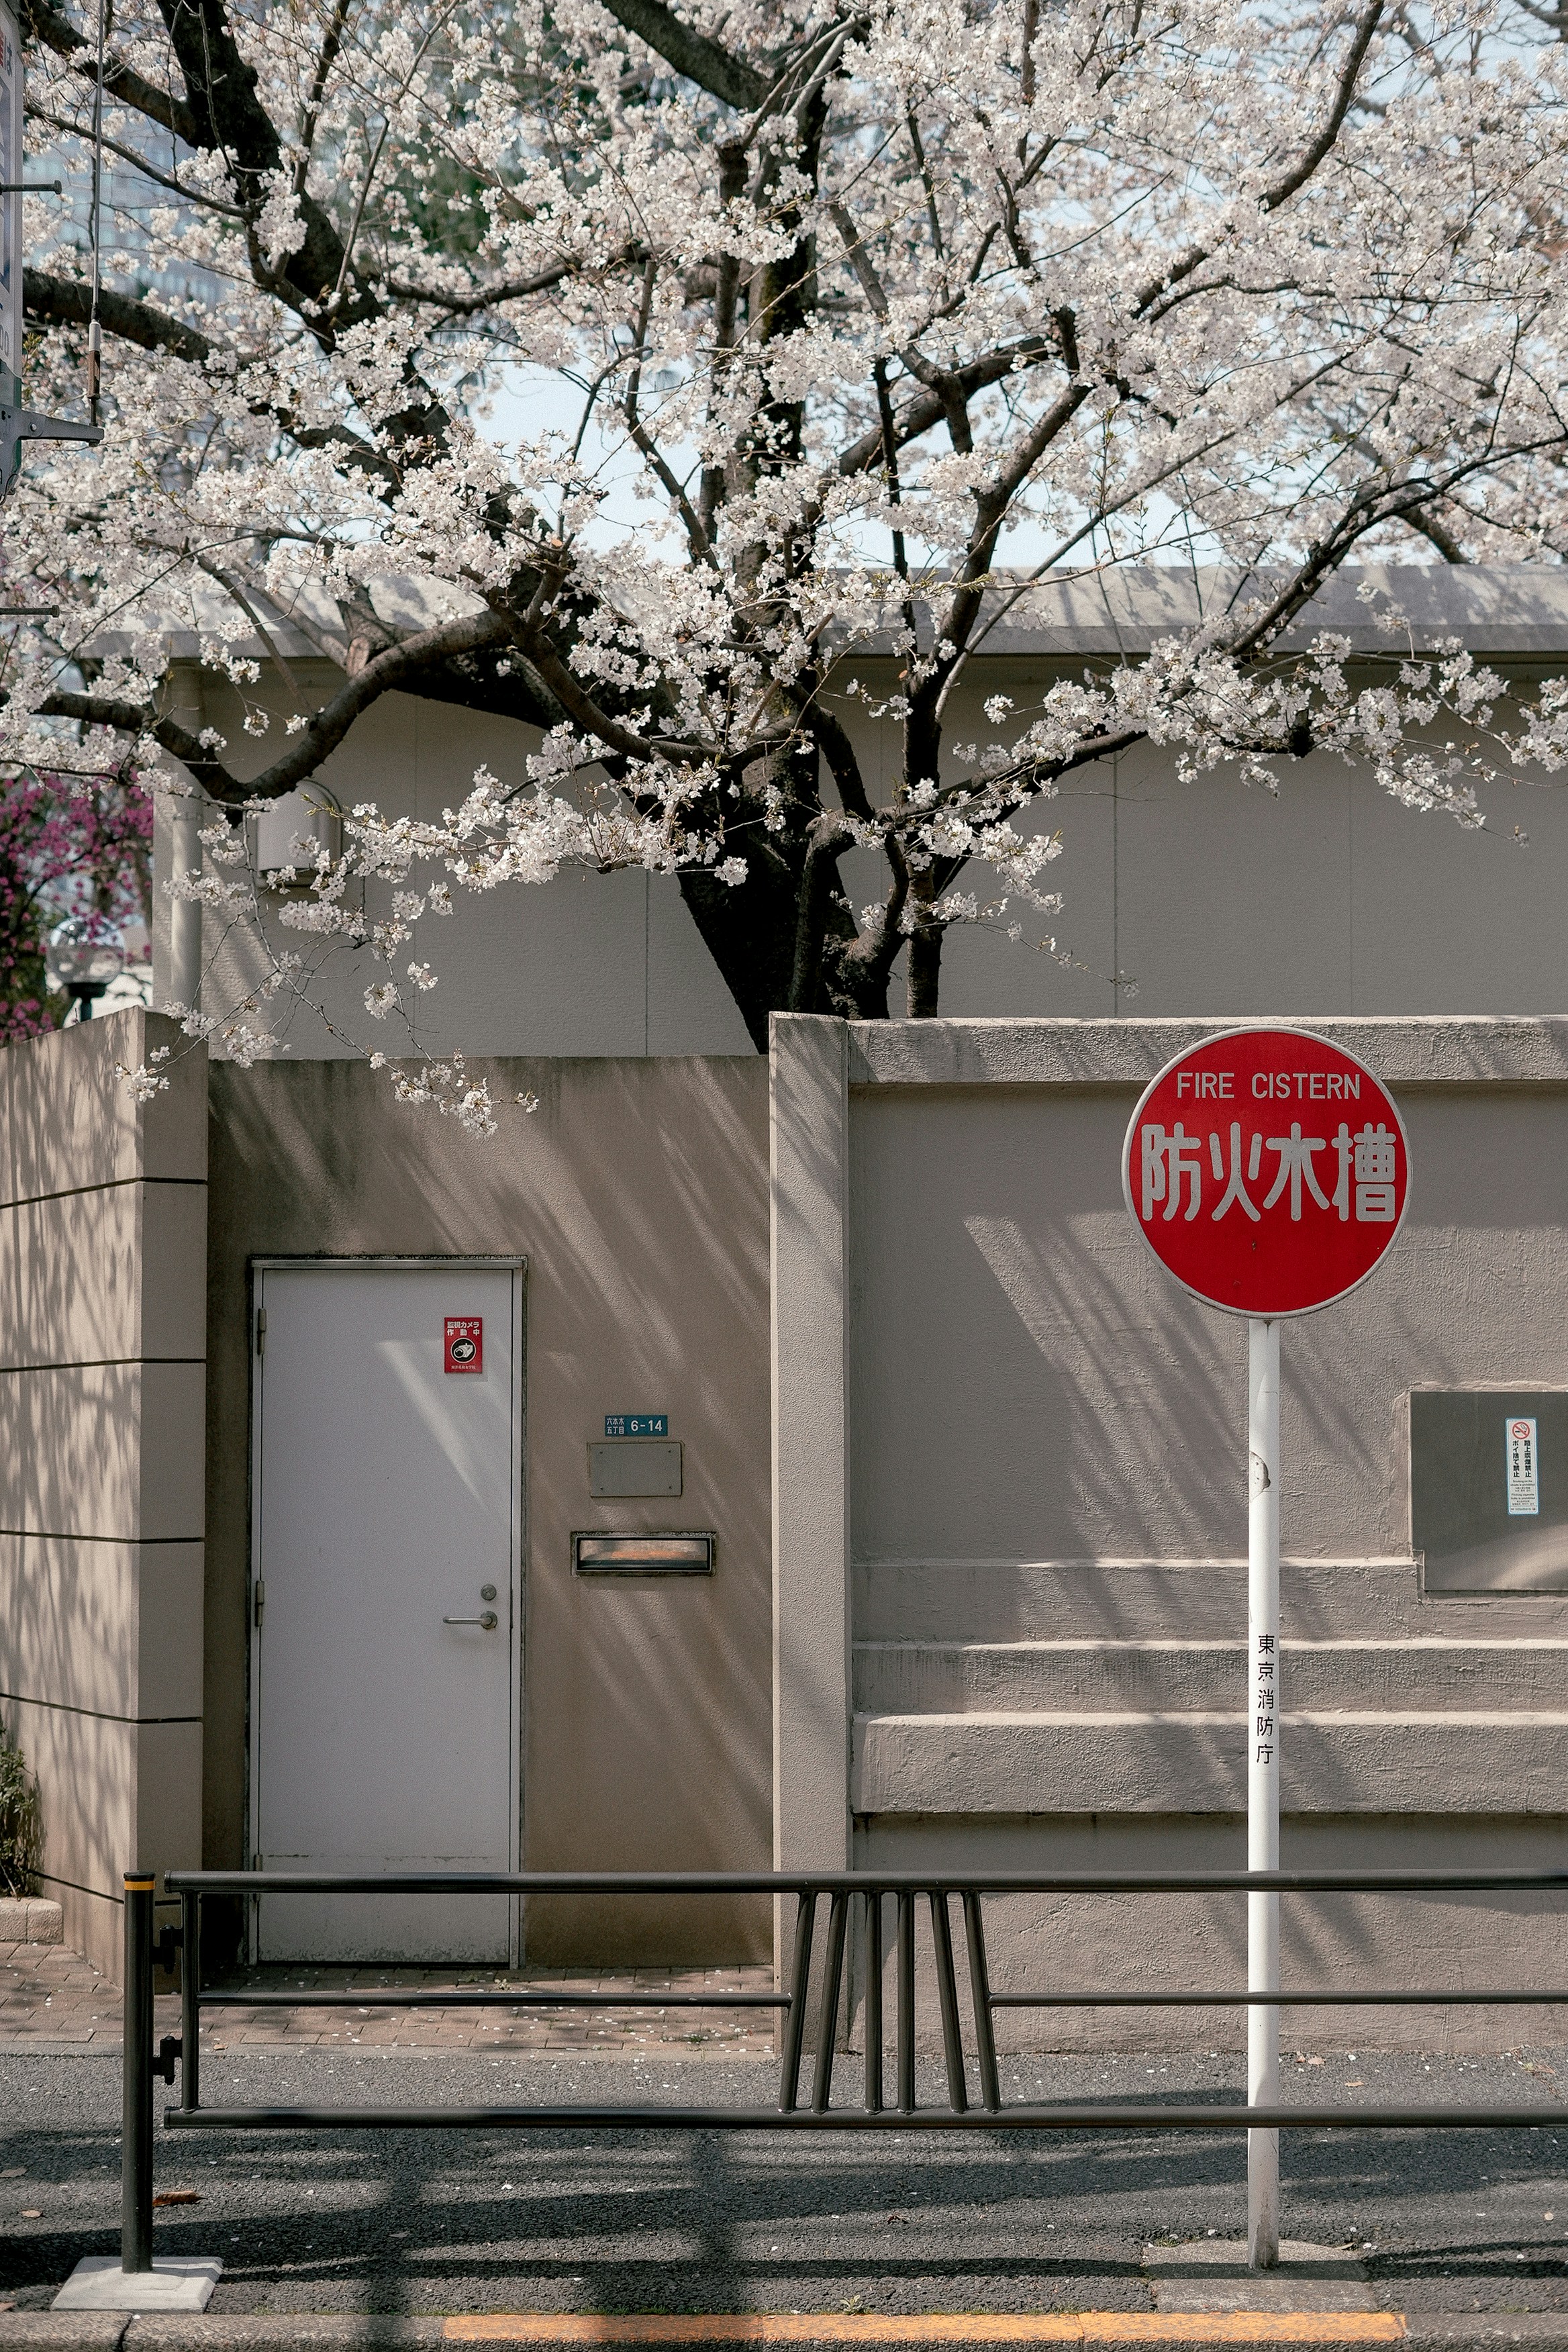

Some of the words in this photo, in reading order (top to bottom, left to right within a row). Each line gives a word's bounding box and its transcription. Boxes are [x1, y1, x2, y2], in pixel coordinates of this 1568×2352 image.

[1177, 1072, 1234, 1099] FIRE
[1251, 1073, 1361, 1099] CISTERN
[1141, 1122, 1396, 1222] 防火水槽
[606, 1417, 624, 1425] 六本木
[607, 1426, 624, 1434] 五丁目
[630, 1420, 663, 1432] 6-14
[1257, 1634, 1275, 1764] 東京消防庁
